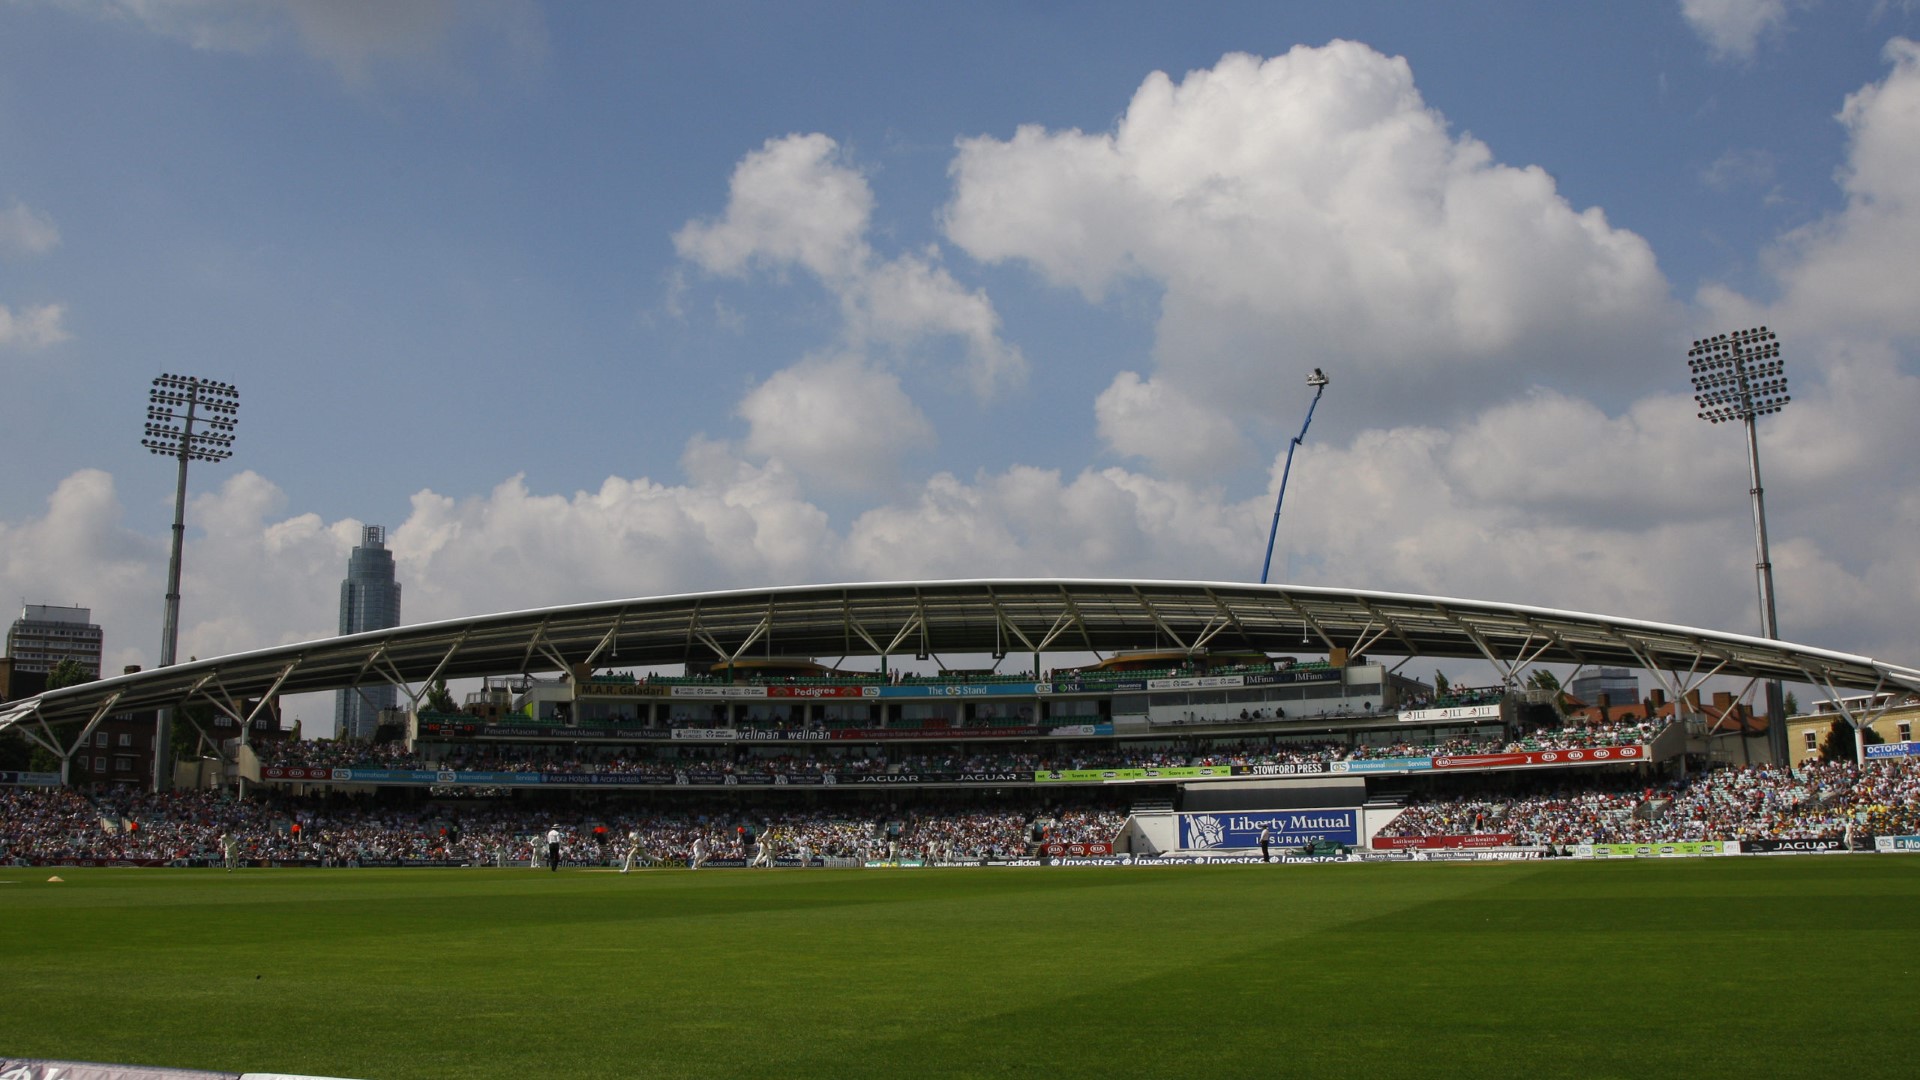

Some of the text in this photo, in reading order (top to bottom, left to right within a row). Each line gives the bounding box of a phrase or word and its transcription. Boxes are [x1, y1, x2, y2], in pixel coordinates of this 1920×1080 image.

[620, 686, 664, 695] Galadari
[794, 687, 836, 697] Pedigree
[928, 686, 943, 695] The
[963, 685, 987, 694] Stand
[737, 730, 779, 739] wellman
[787, 730, 831, 739] wellman
[1867, 744, 1909, 753] OCTOPUS
[1253, 763, 1323, 775] STOWFORD PRESS
[1351, 762, 1386, 770] International
[857, 775, 919, 783] JAGUAR
[955, 773, 1017, 781] JAGUAR
[1229, 813, 1349, 834] Liberty Mutual
[1255, 835, 1325, 844] ISURANCE
[1431, 850, 1452, 858] Liberty
[1477, 851, 1523, 859] YORKSHIRE
[1062, 858, 1120, 866] Investec
[1134, 857, 1193, 865] Investec
[1207, 856, 1265, 864] Investec
[1282, 855, 1344, 863] Investec
